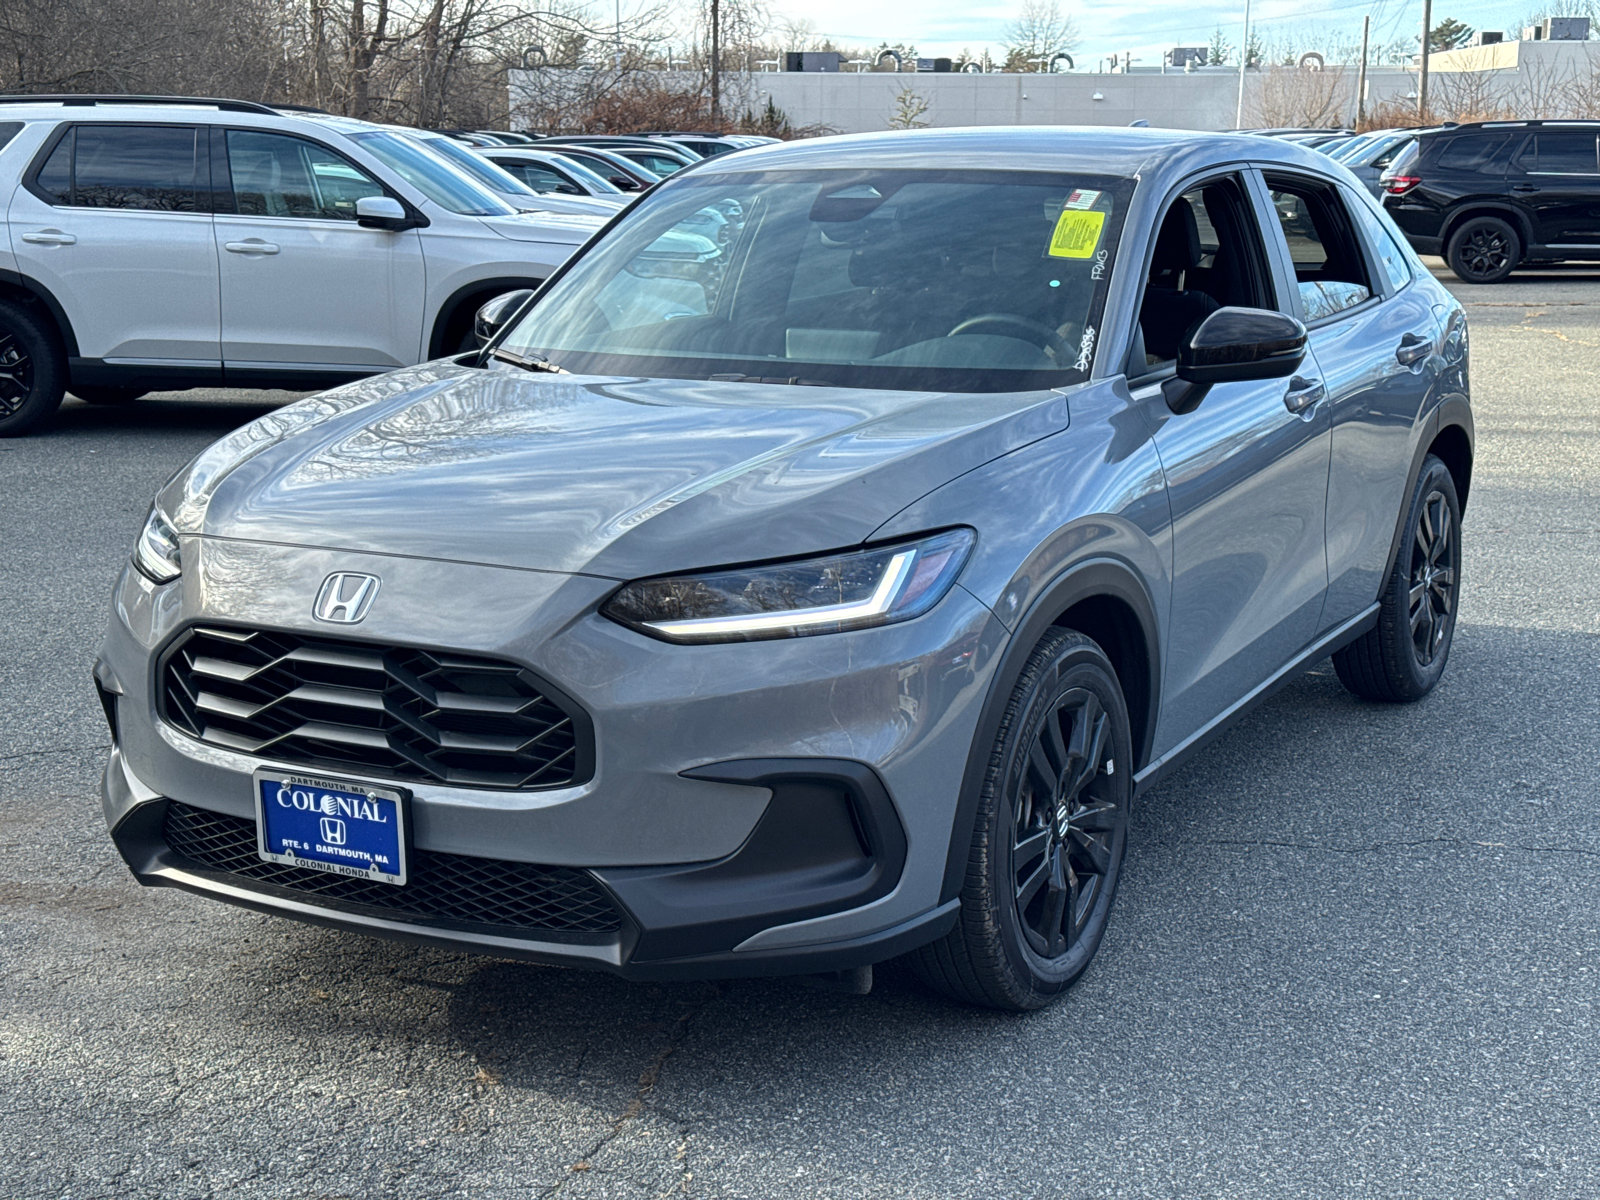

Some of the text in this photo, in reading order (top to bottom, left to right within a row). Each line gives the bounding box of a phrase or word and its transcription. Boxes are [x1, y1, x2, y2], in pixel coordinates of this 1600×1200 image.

[351, 786, 365, 794] MA
[276, 788, 387, 823] COLONIAL
[282, 838, 389, 864] RTE. 6 DARTMOUTH, MA
[294, 858, 370, 879] COLONIAL HONDA
